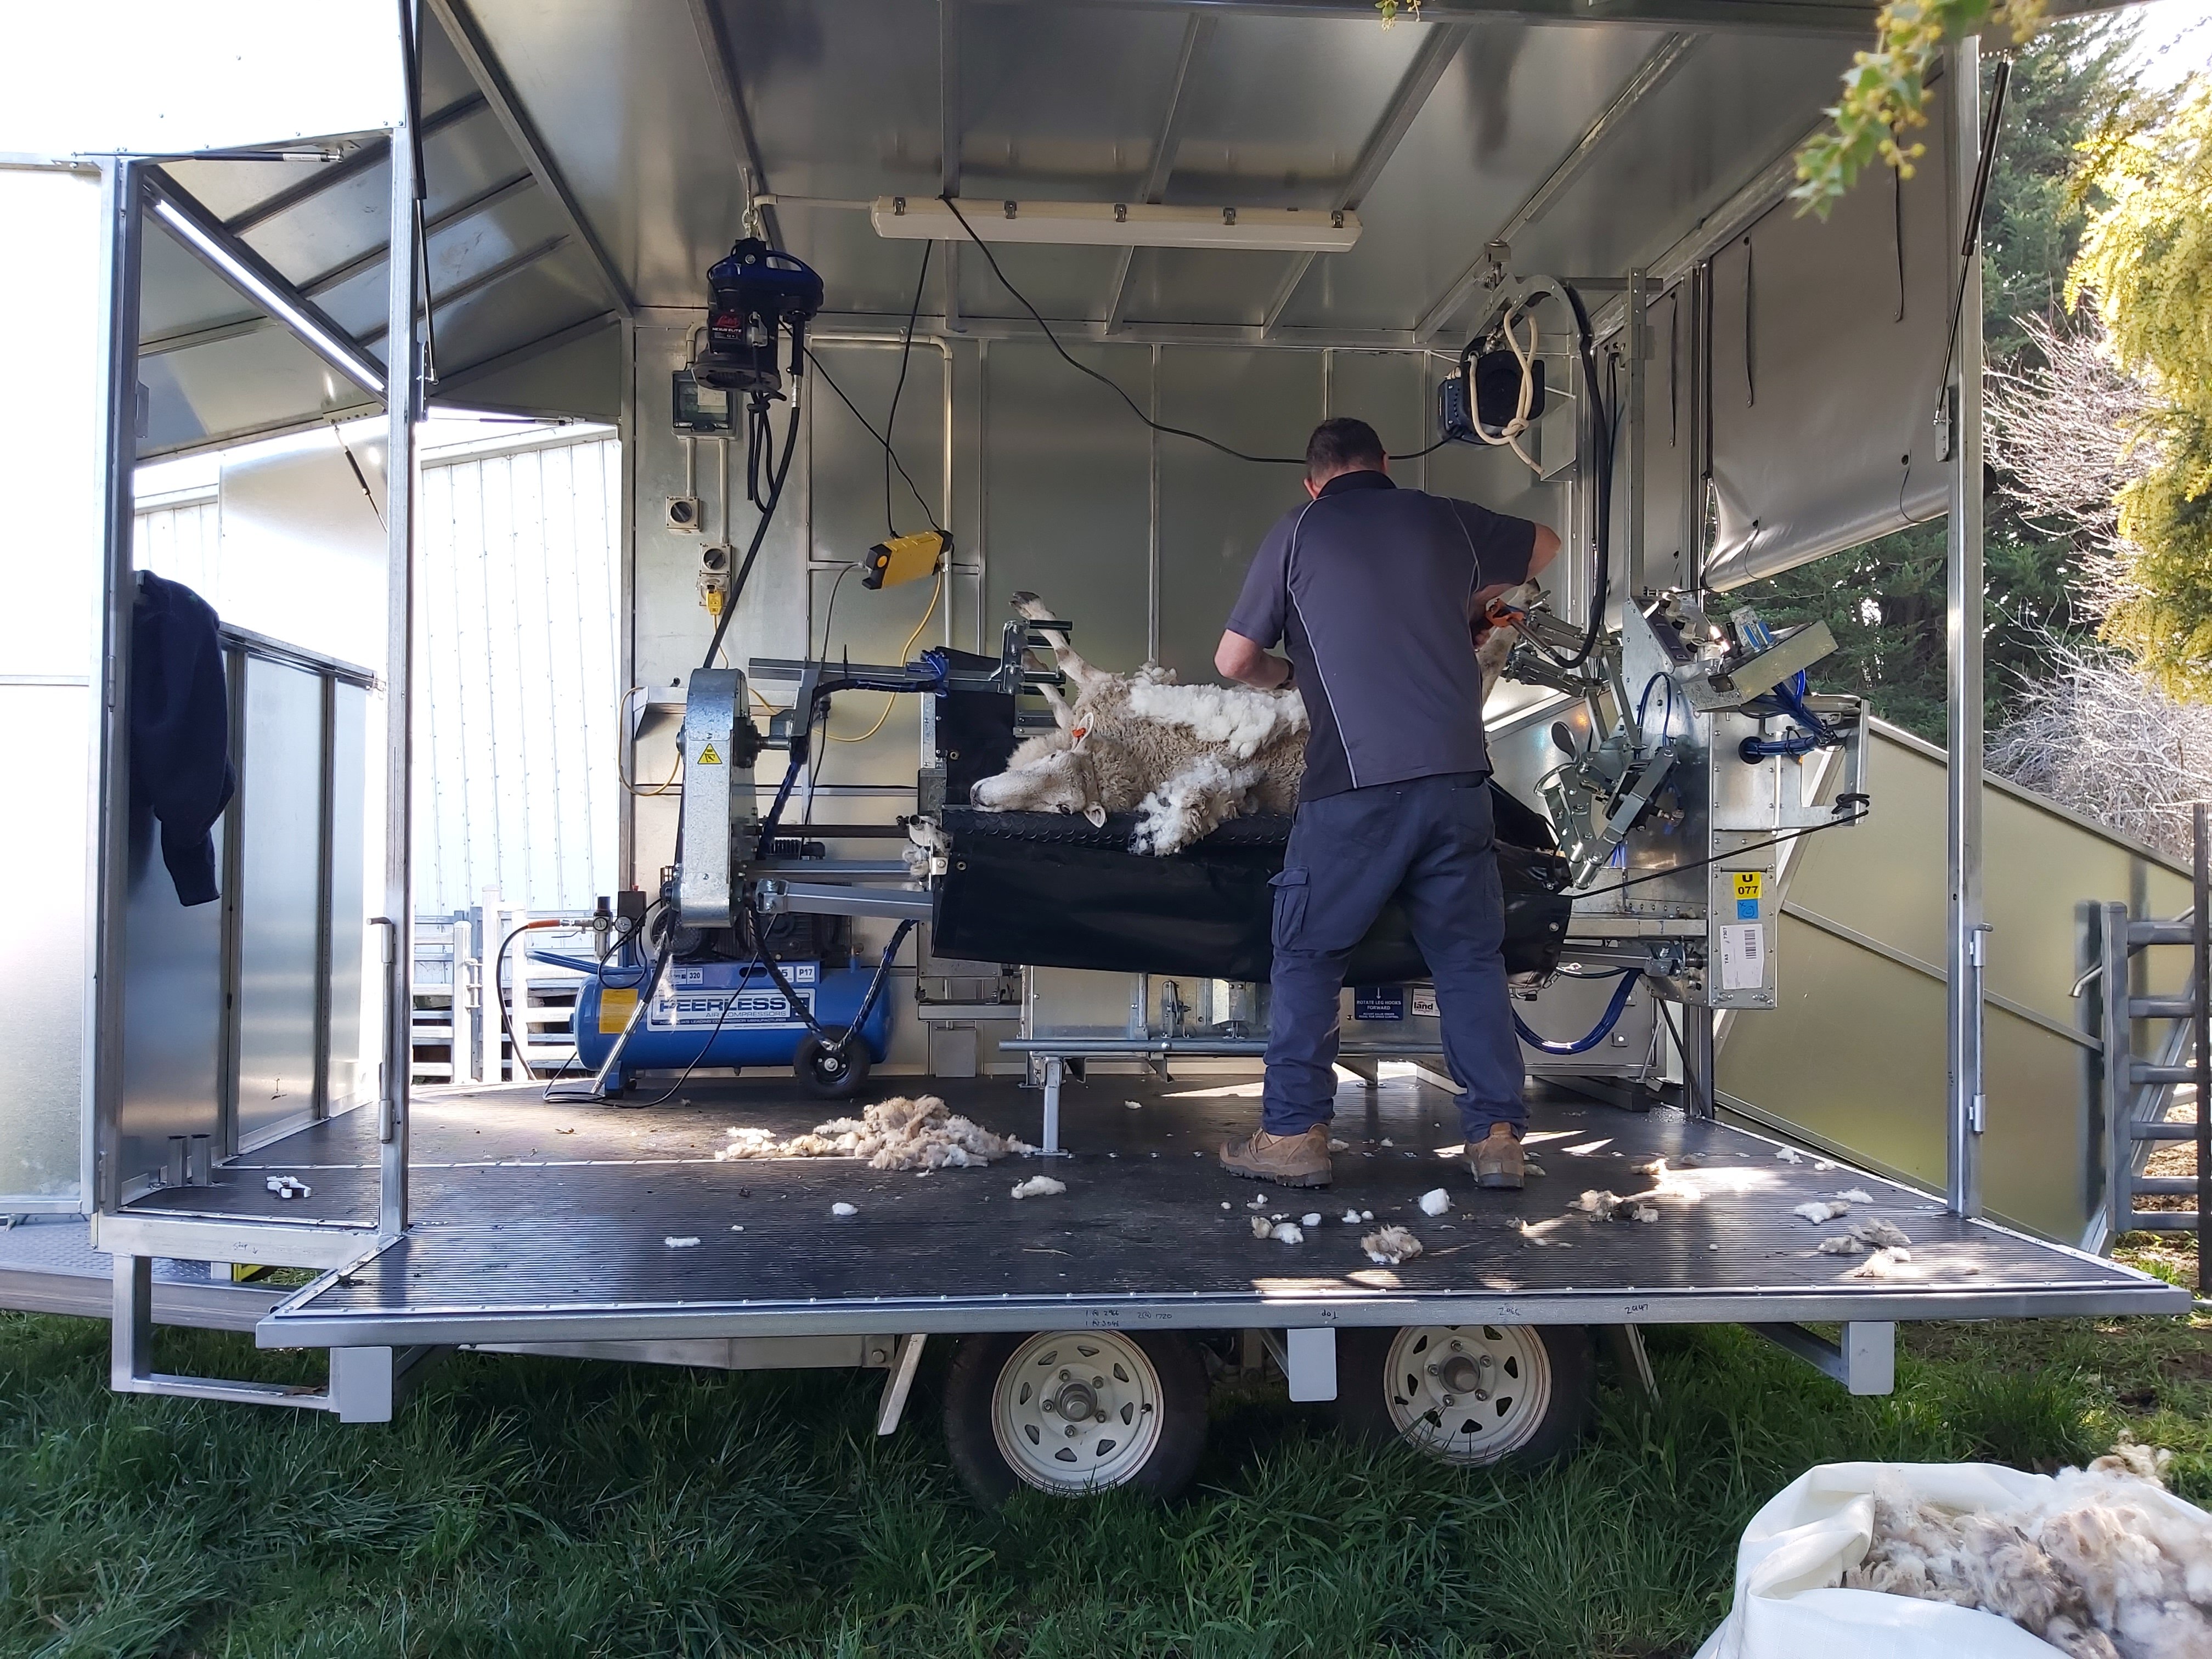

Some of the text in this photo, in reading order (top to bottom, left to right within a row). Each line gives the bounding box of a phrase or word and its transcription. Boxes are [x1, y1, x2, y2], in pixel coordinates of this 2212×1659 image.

[1742, 874, 1753, 882] U
[1737, 885, 1758, 895] 077
[659, 997, 787, 1012] PEERLESS
